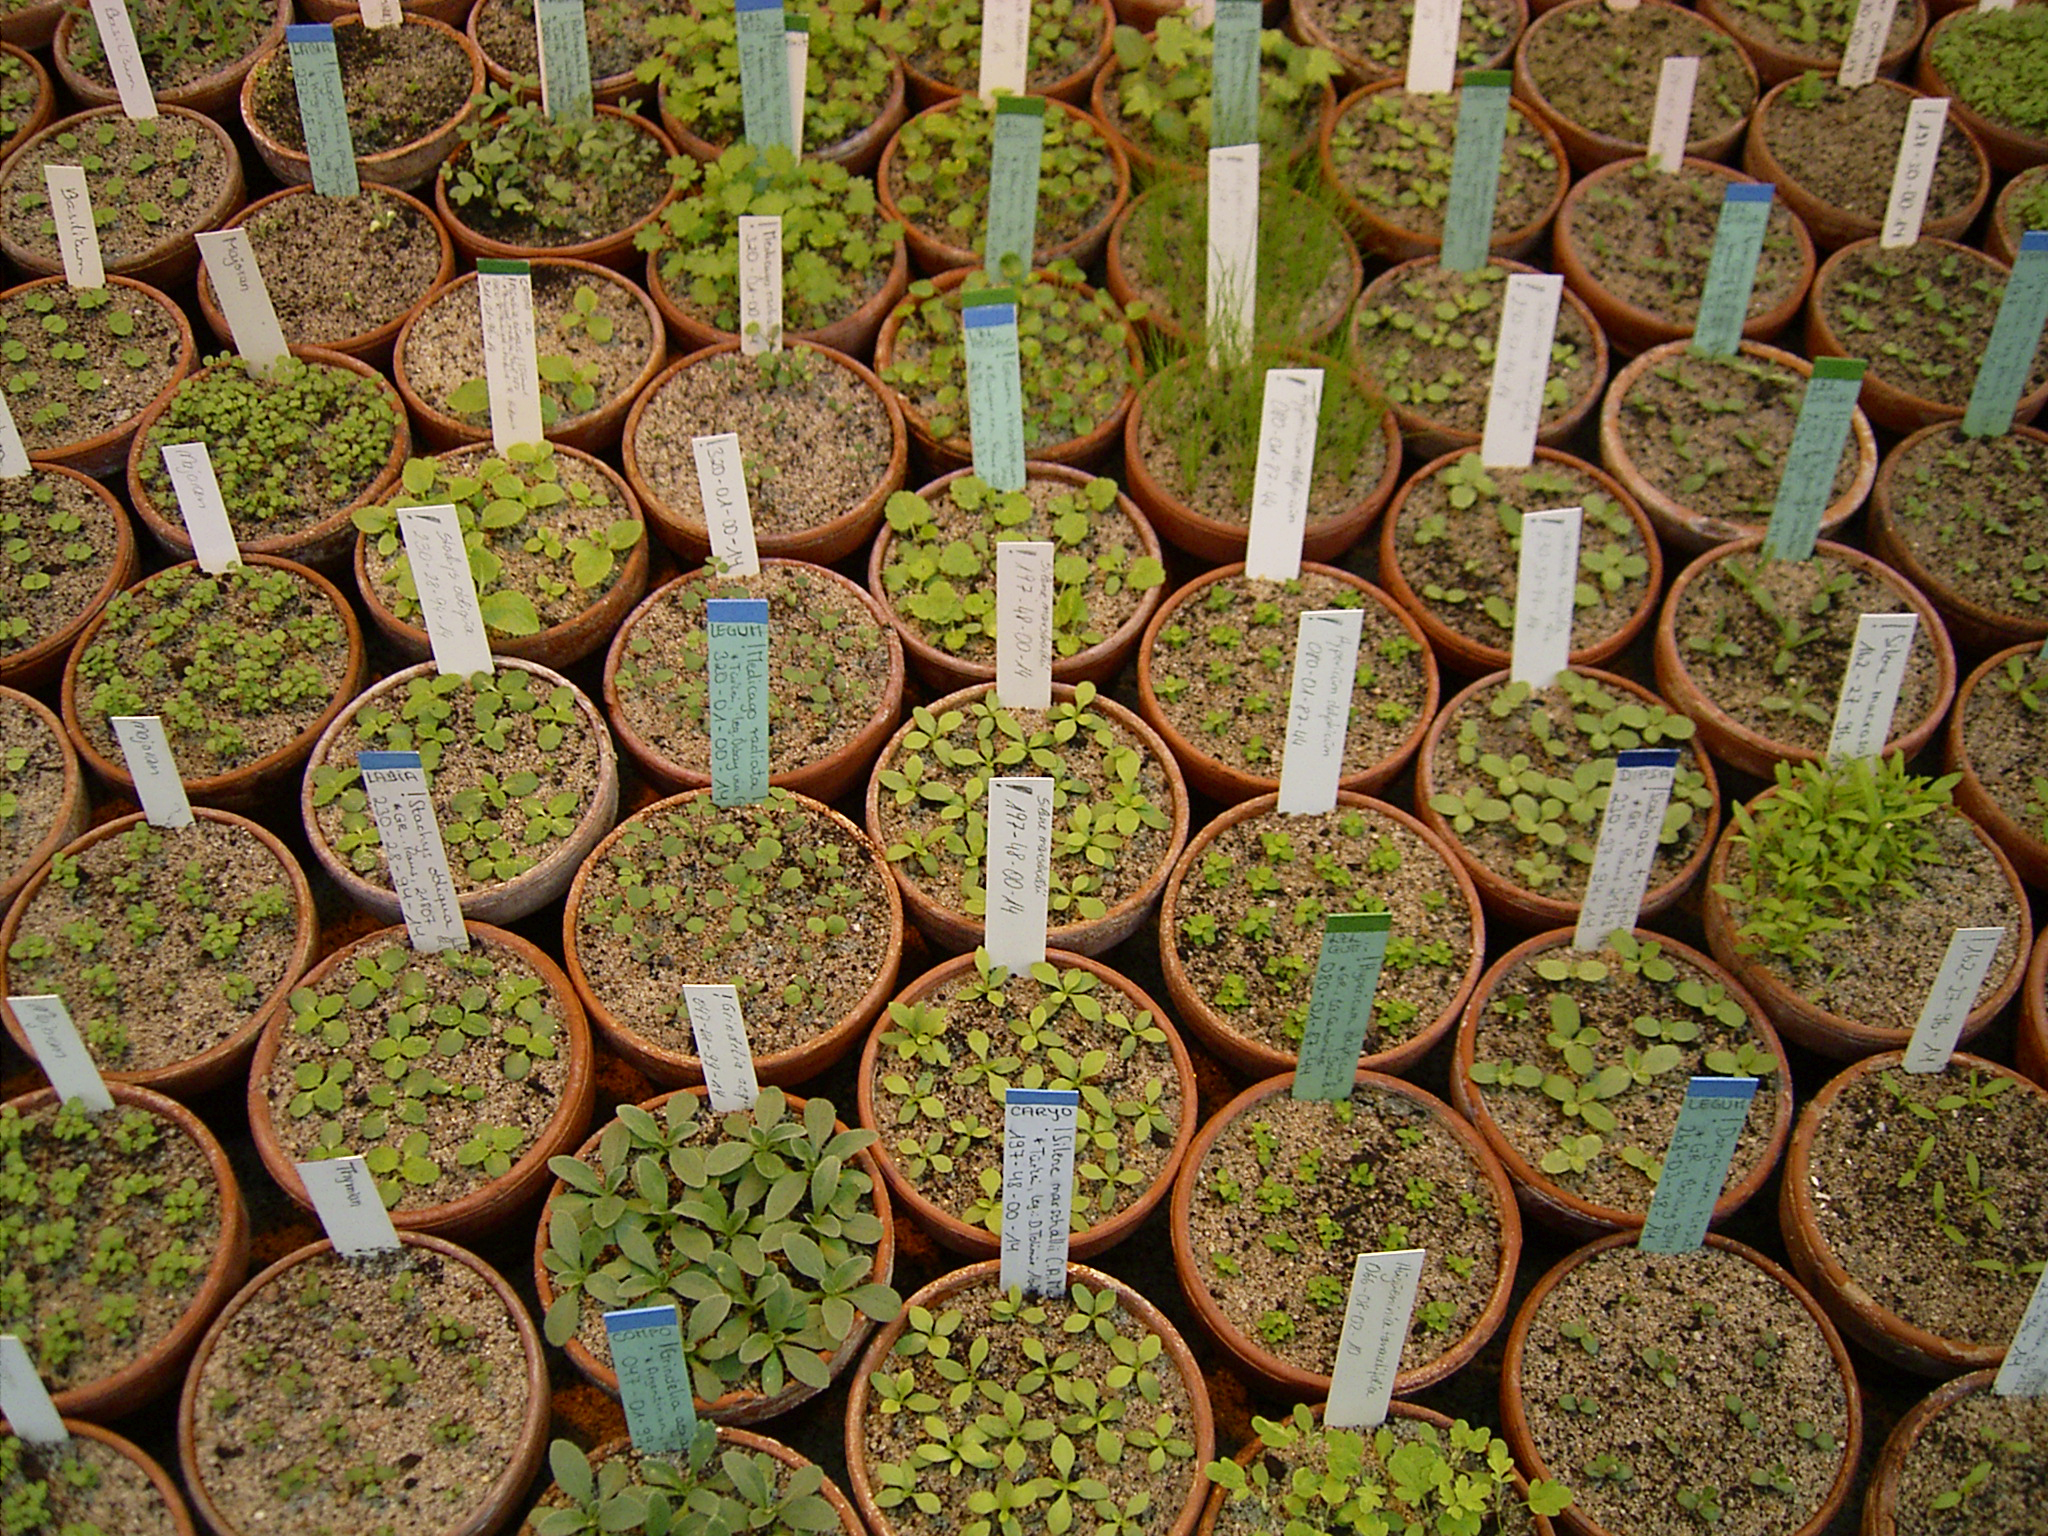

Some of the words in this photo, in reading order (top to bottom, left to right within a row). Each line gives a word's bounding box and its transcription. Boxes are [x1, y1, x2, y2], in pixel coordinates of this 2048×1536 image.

[222, 236, 249, 292] Majoran
[174, 449, 207, 509] Majoran
[1004, 1129, 1025, 1252] 197-48-00-14
